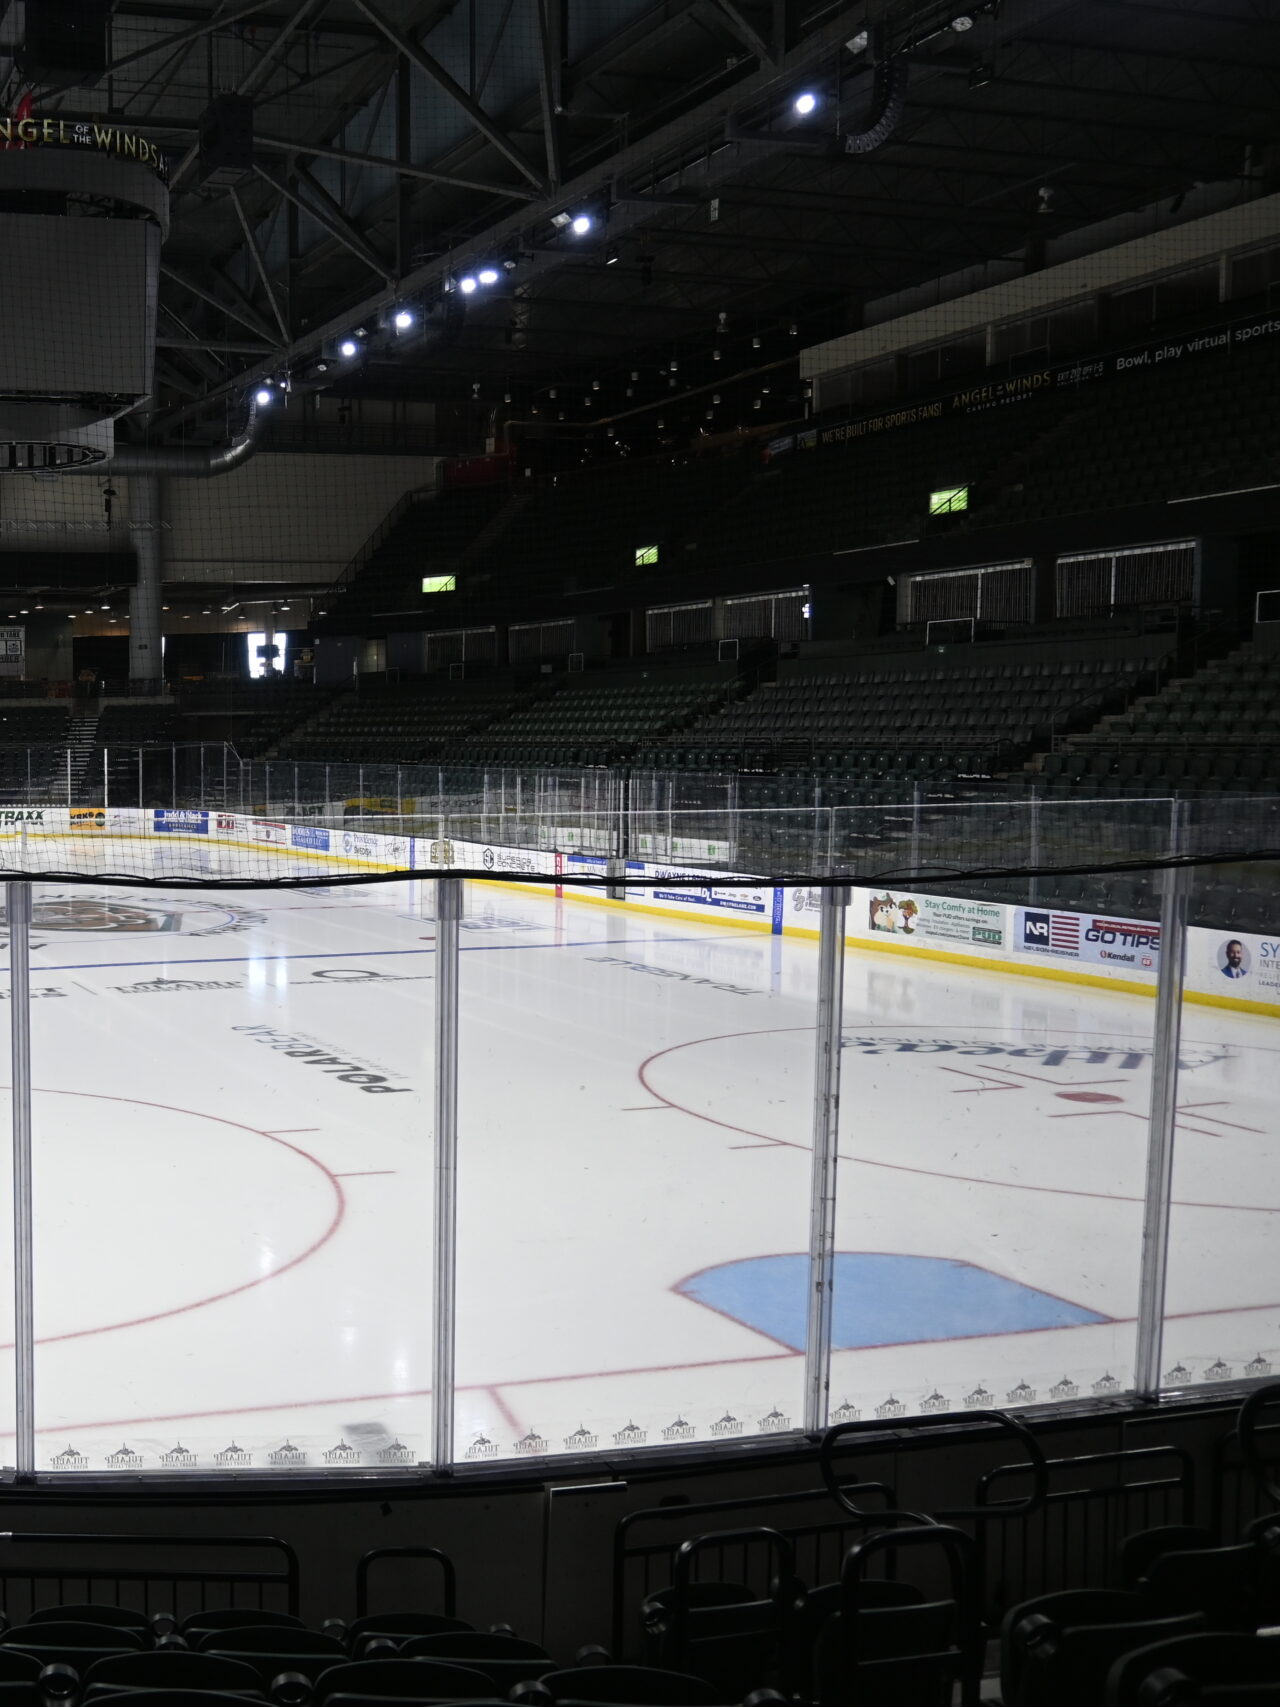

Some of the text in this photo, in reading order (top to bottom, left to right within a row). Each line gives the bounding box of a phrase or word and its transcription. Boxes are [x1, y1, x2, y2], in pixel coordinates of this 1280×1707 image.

[75, 124, 89, 134] OF
[73, 134, 92, 145] THE
[94, 124, 159, 168] WINDS
[1116, 320, 1280, 370] Bowl, play virtual sports
[953, 386, 994, 408] ANGEL
[1005, 371, 1051, 394] WINDS
[821, 428, 846, 444] WE'RE
[846, 420, 867, 438] BUILT
[868, 416, 883, 432] FOR
[884, 410, 917, 428] SPORTS
[497, 854, 531, 865] SUPERIOR
[497, 861, 536, 872] CONCRETE
[925, 899, 1000, 918] Stay Comfy at Home
[1085, 928, 1160, 951] GO TIPS
[1023, 945, 1079, 957] NELSON-REISNER
[1107, 952, 1135, 962] Kendall
